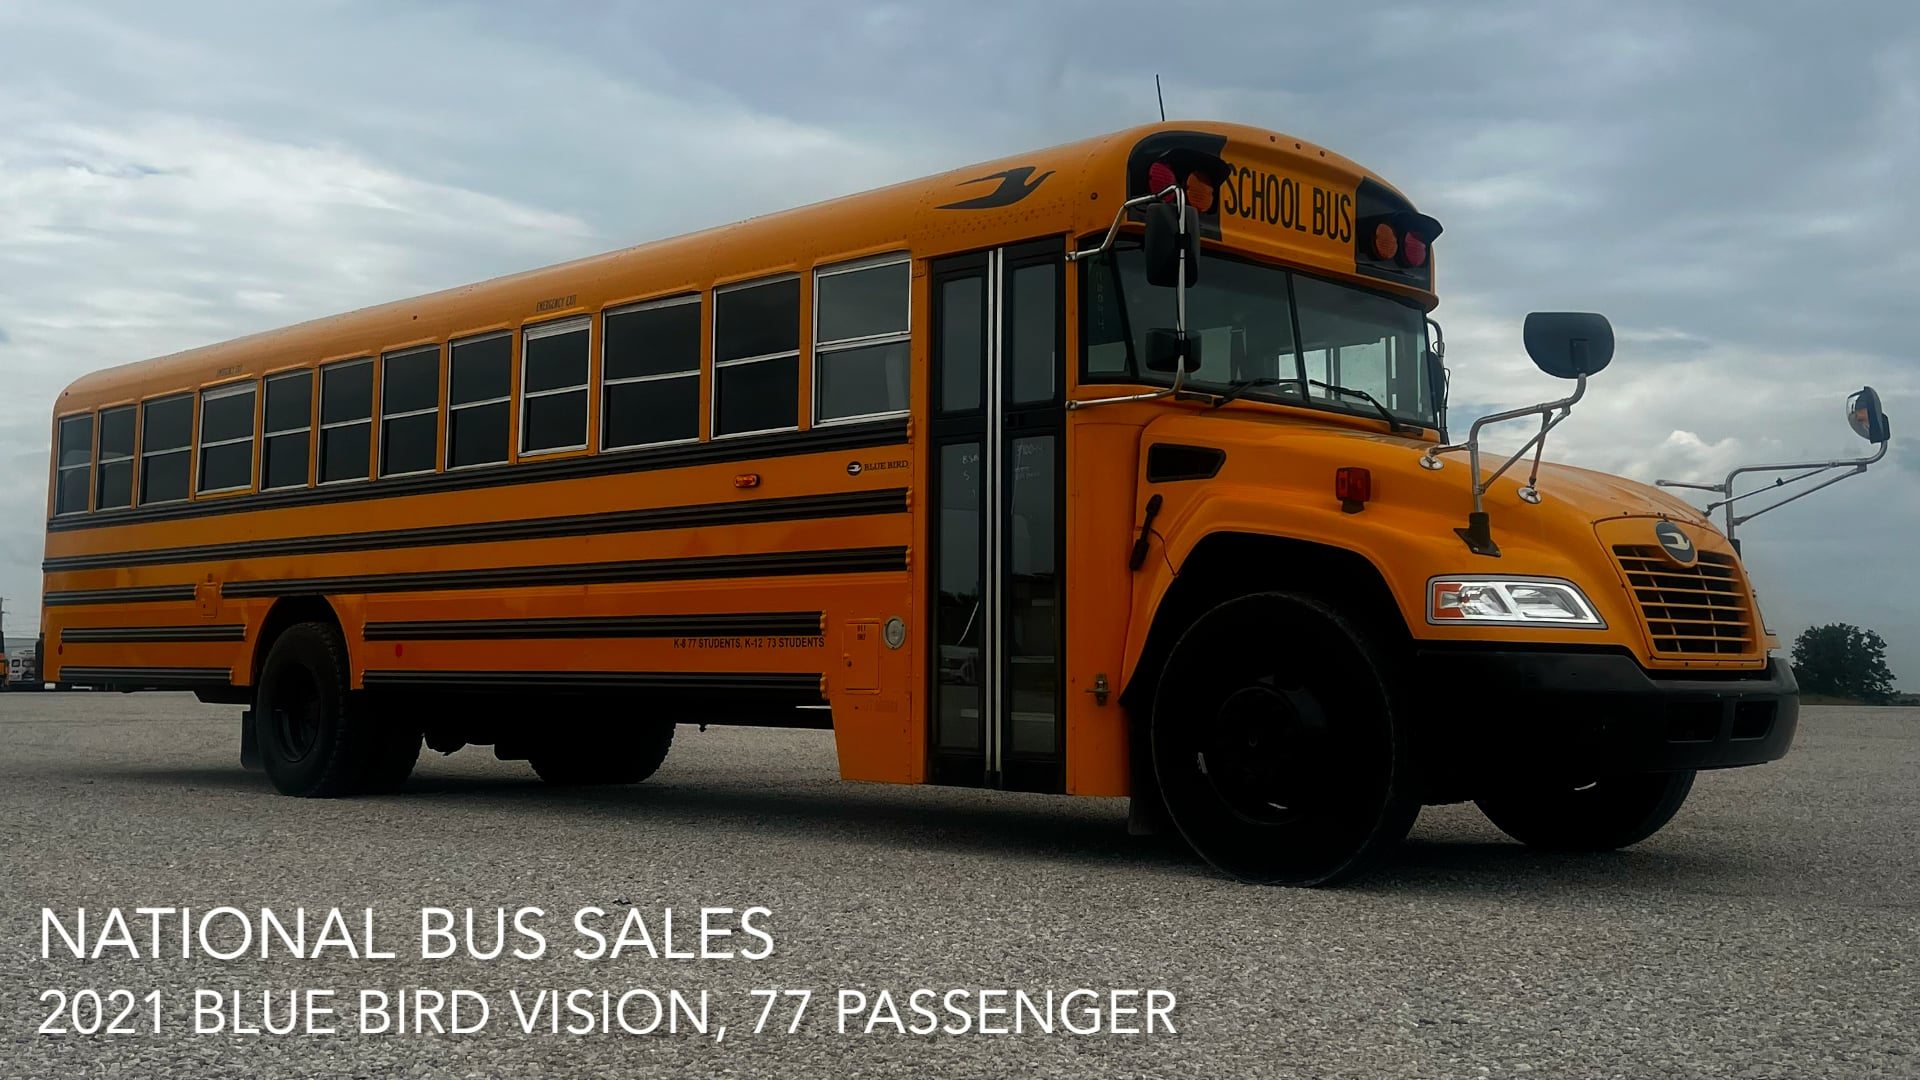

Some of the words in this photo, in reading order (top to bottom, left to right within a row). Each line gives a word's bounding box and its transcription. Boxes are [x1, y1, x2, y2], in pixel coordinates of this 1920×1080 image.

[1223, 163, 1307, 232] SCHOOL
[1312, 187, 1352, 243] BUS
[864, 463, 886, 471] BLUE
[887, 460, 909, 469] BIRD
[687, 638, 697, 649] 77
[745, 637, 763, 648] K-12
[767, 637, 777, 648] 73
[778, 636, 825, 648] STUDENTS
